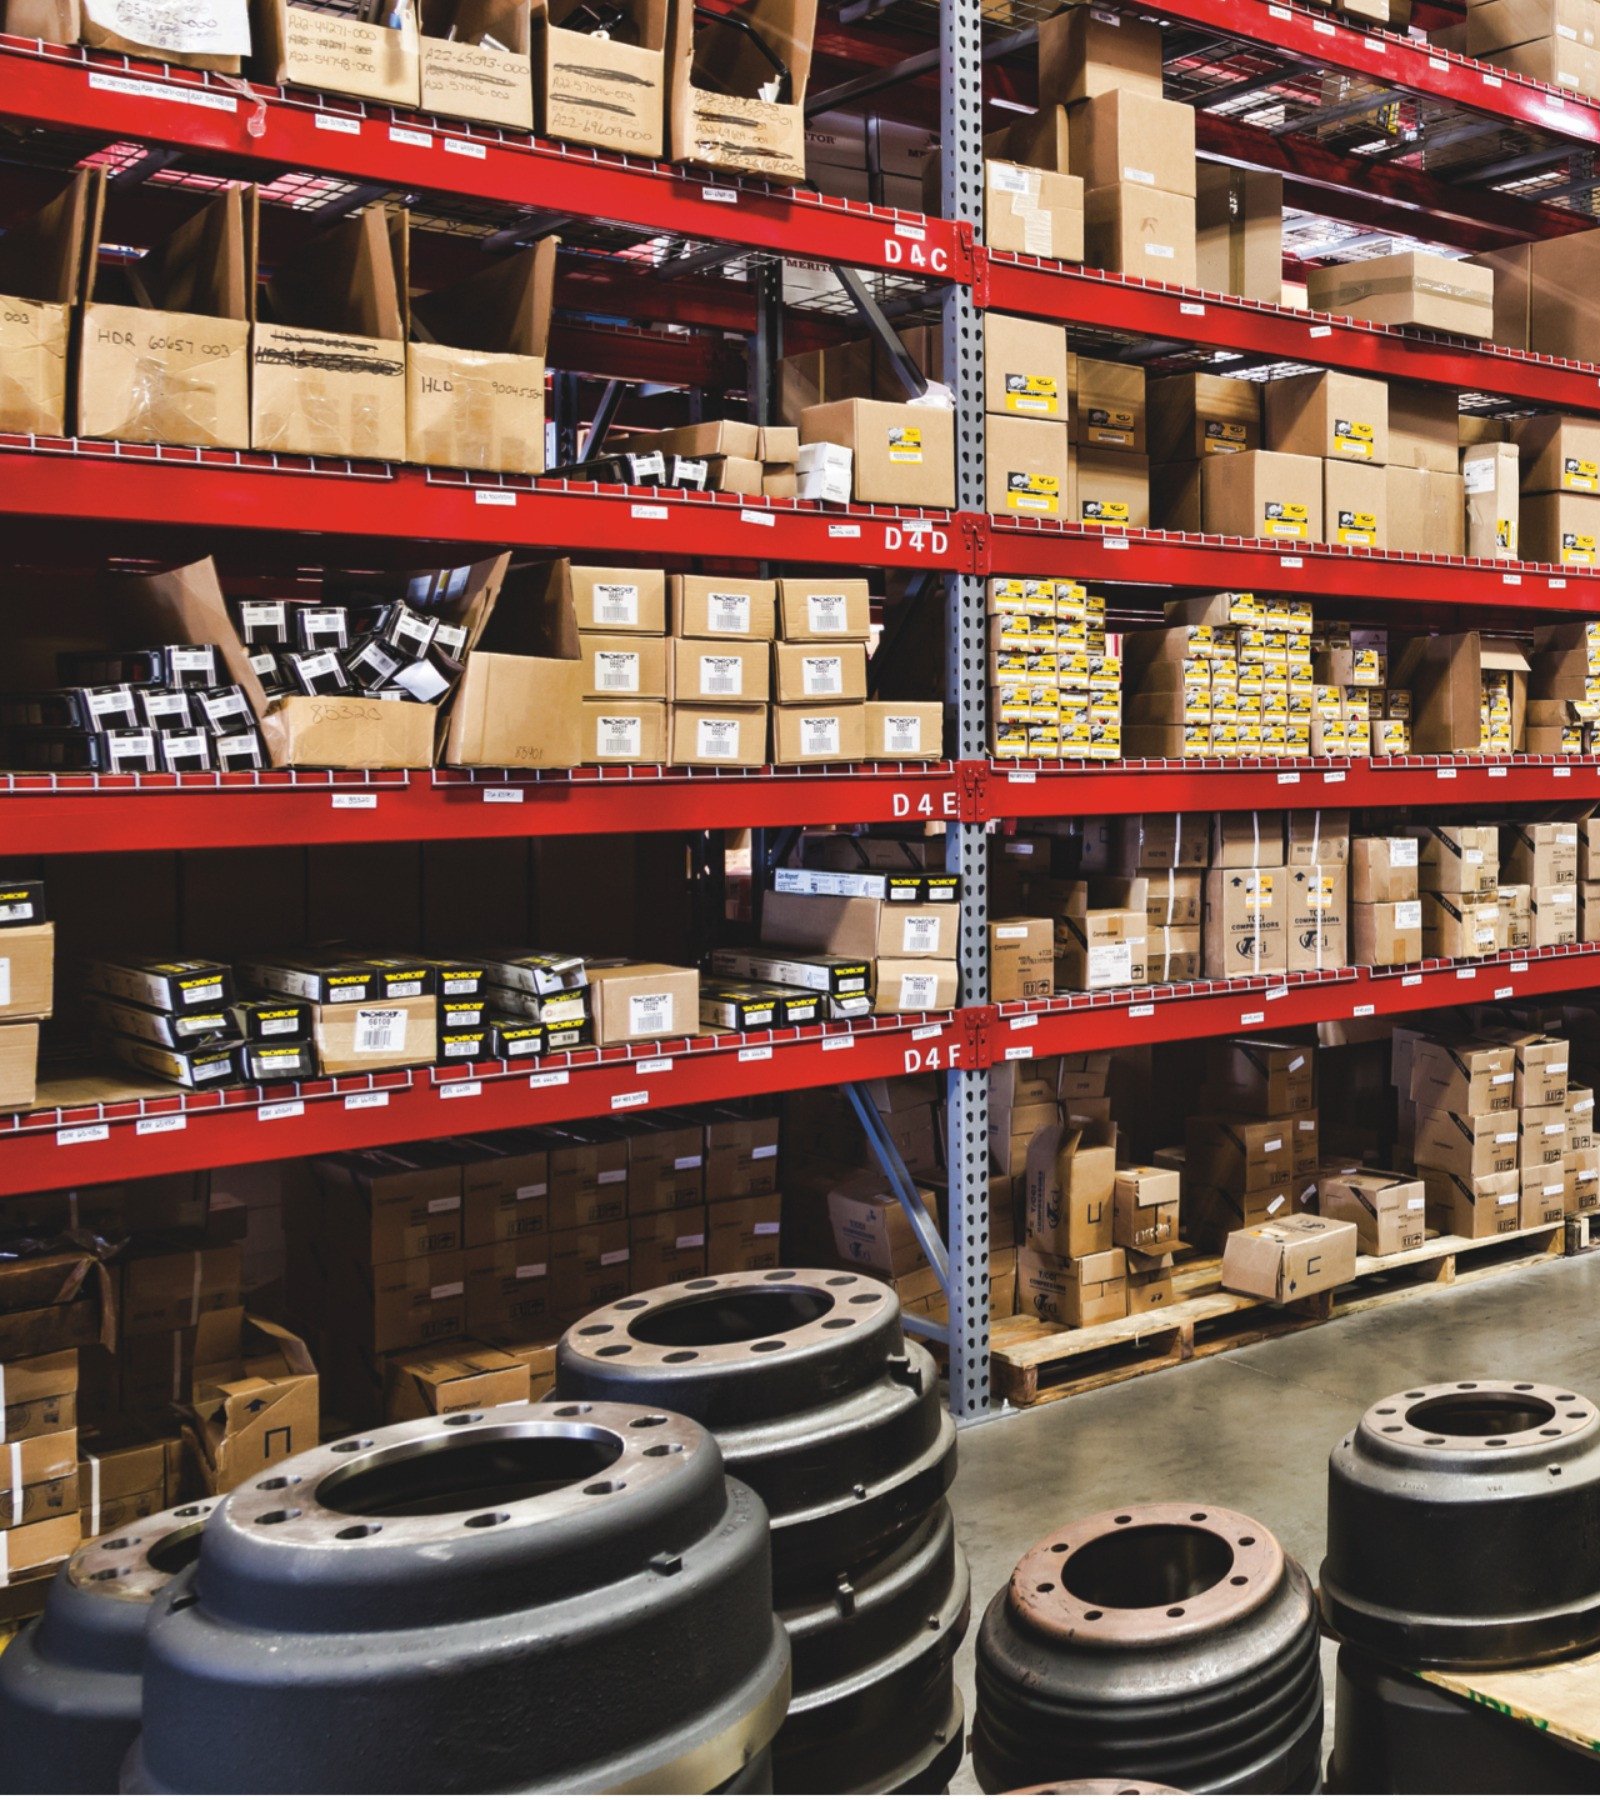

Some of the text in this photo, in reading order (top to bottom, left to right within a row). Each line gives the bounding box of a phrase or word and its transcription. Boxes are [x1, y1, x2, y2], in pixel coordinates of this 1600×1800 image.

[4, 312, 30, 324] 003
[97, 328, 231, 358] HDR 60657 003
[421, 376, 454, 393] HLD
[309, 704, 383, 724] 85320
[1231, 921, 1279, 931] COMPRSORS
[1295, 917, 1340, 925] COMPRSORS
